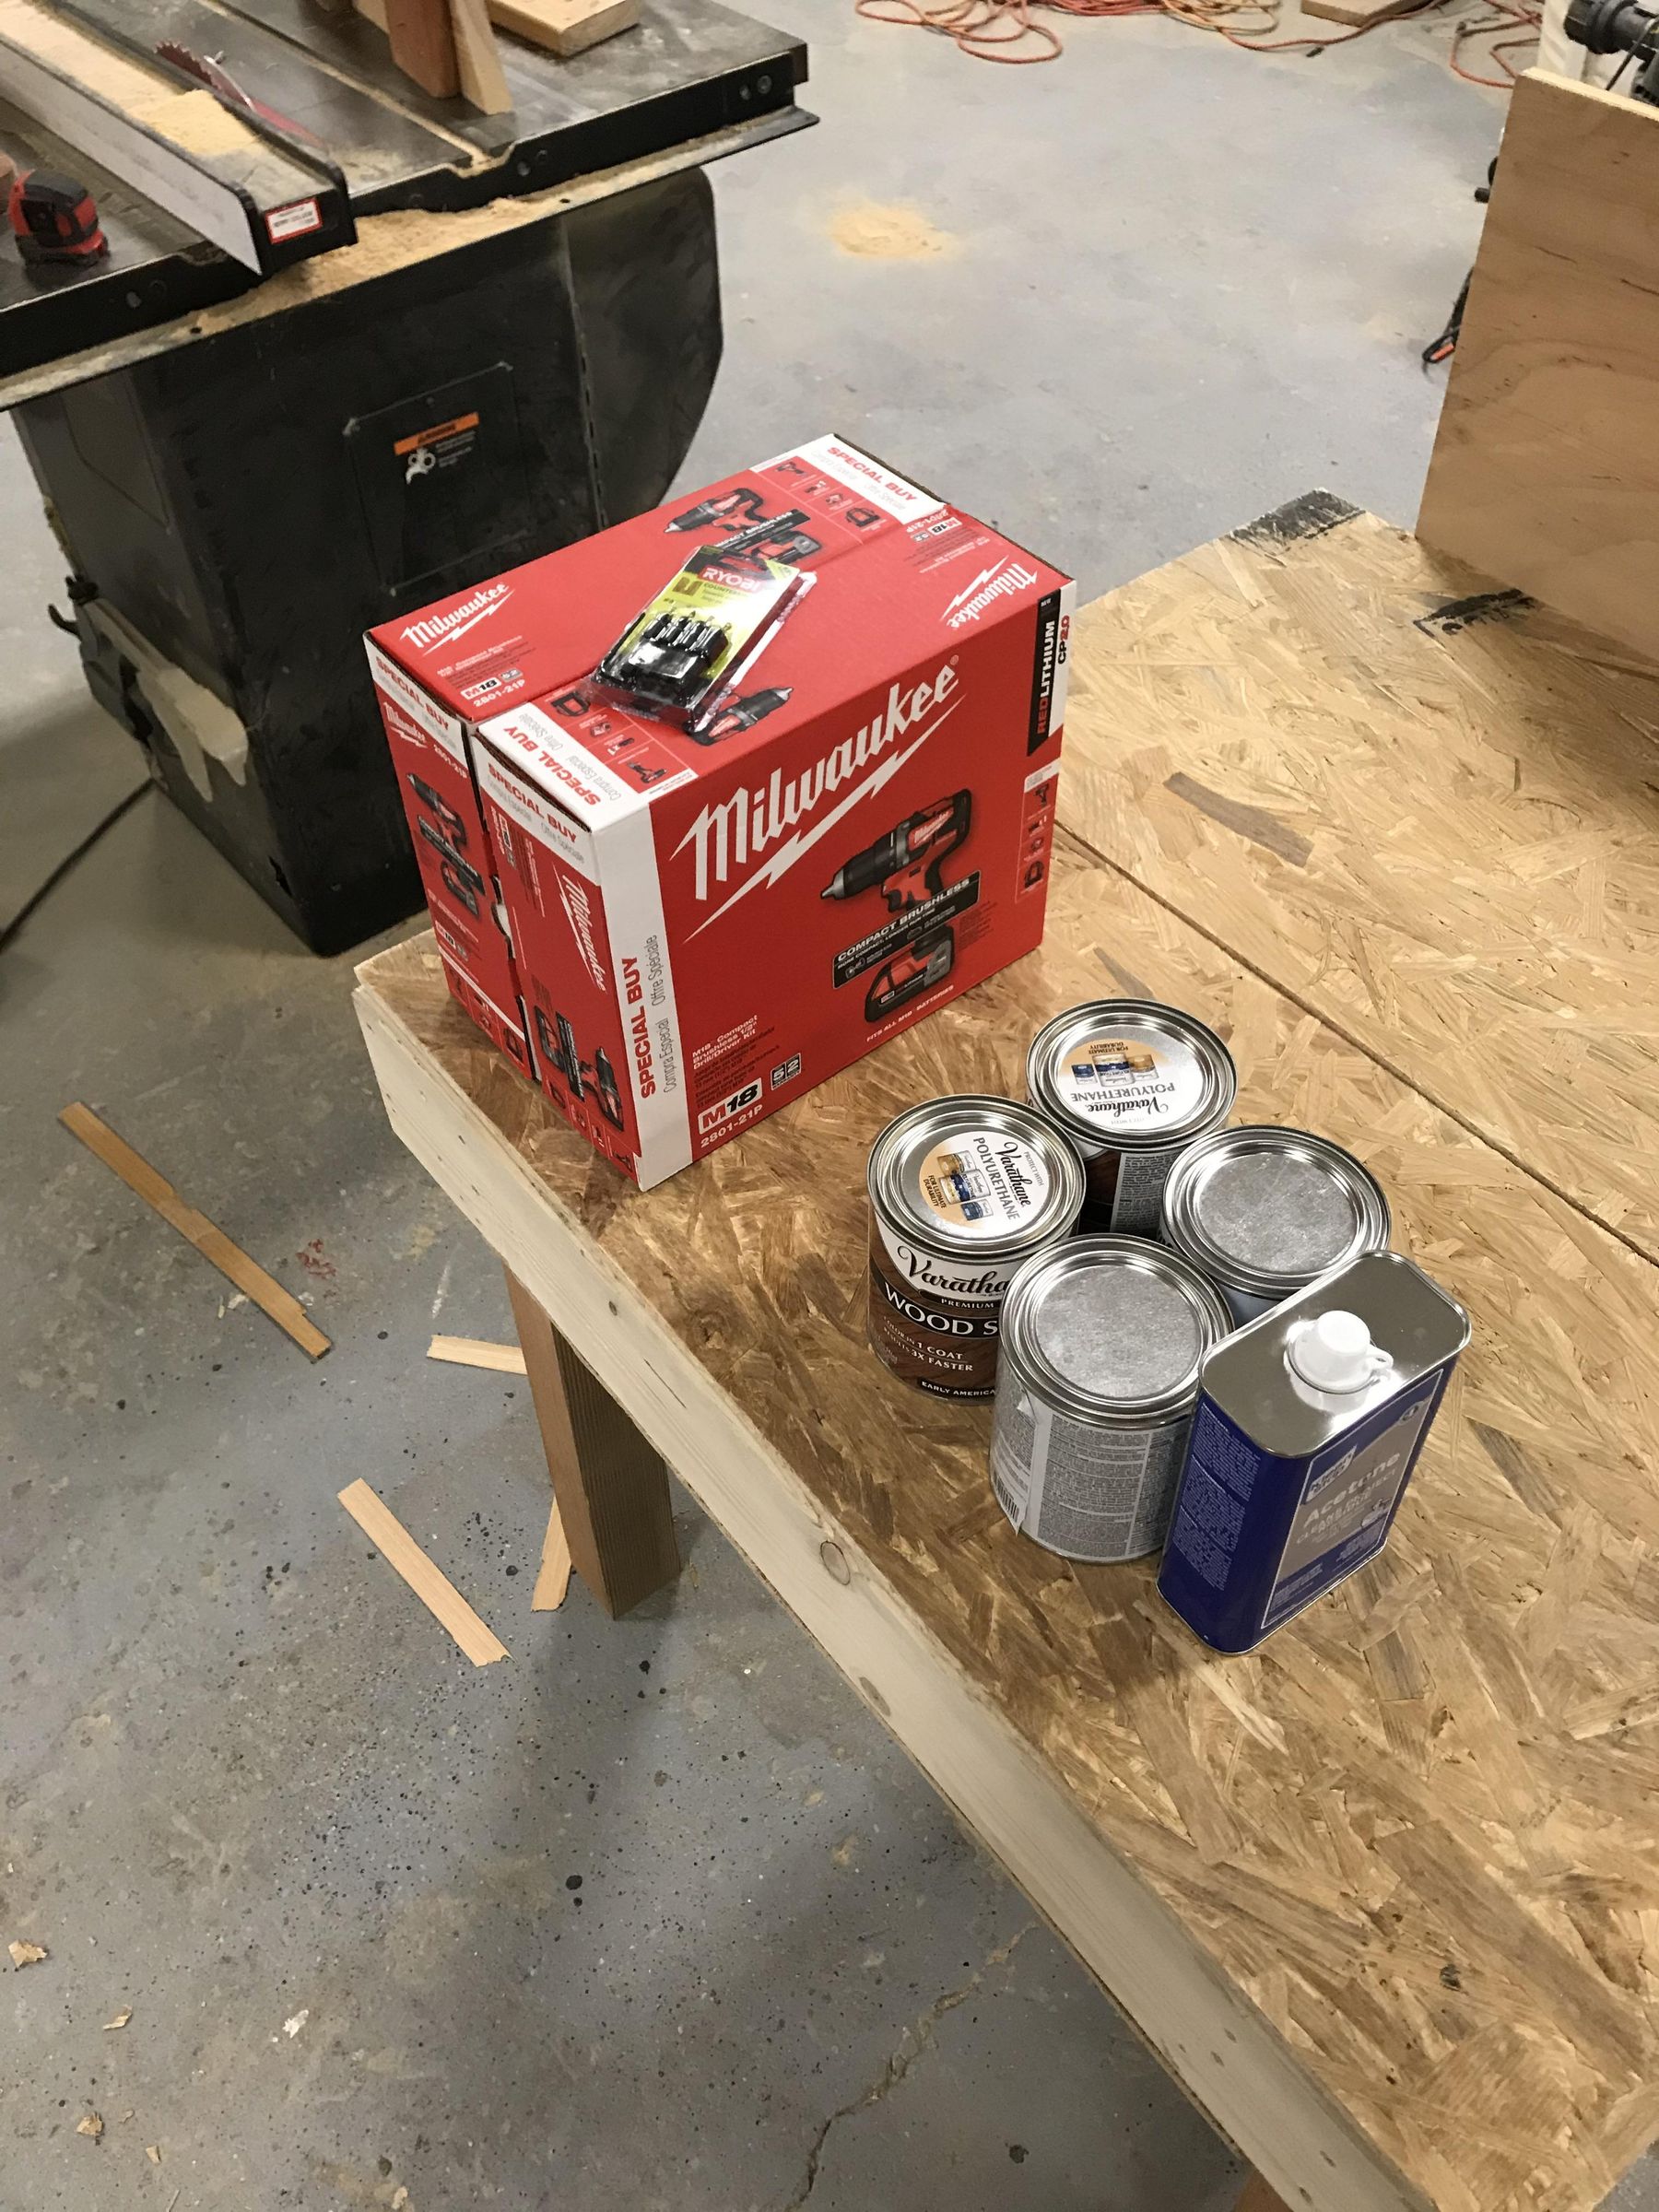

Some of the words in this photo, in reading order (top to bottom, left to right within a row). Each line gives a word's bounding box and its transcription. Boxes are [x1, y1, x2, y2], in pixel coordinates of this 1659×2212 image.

[828, 446, 885, 484] SPECIAL
[885, 482, 918, 501] BUY
[702, 567, 762, 591] RYOBI
[947, 563, 1038, 629] Milwaukee
[399, 582, 510, 648] Milwaukee
[464, 678, 499, 698] M18
[474, 679, 524, 707] 2801-21P
[1037, 620, 1055, 735] REDLITHIUM
[504, 725, 539, 751] BUY
[538, 750, 601, 806] SPECIAL
[670, 665, 959, 900] Milwaukee
[488, 762, 545, 818] SPECIAL
[547, 813, 577, 842] BUY
[562, 875, 607, 994] Milwaukee
[837, 922, 897, 961] COMPACT
[900, 878, 970, 924] BRUSHLESS
[621, 957, 643, 1004] BUY
[651, 980, 665, 1006] Offre
[655, 1018, 675, 1060] Especial
[692, 1042, 711, 1057] M18
[717, 1015, 758, 1042] Compact
[884, 1021, 897, 1031] ALL
[630, 1006, 655, 1099] SPECIAL
[693, 1034, 738, 1064] Brushless
[693, 1038, 741, 1069] Drill/Driver
[743, 1029, 756, 1040] Kit
[659, 1056, 677, 1094] Compra
[1071, 1082, 1176, 1102] POLYURETHANE
[700, 1083, 759, 1131] M18
[700, 1104, 763, 1148] 2801-21P
[1087, 1097, 1169, 1118] Varathane
[924, 1179, 939, 1206] DURABILITY
[928, 1175, 937, 1188] FOR
[934, 1184, 947, 1208] ULTIMATE
[973, 1136, 1021, 1220] POLYURETHANE
[995, 1141, 1033, 1208] Varathane
[897, 1245, 1010, 1293] Varatha
[885, 1282, 974, 1335] WOOD
[941, 1298, 994, 1309] PREMIUM
[912, 1348, 924, 1361] 3X
[928, 1357, 973, 1371] FASTER
[927, 1345, 963, 1360] COAT
[922, 1382, 950, 1394] EARLY
[953, 1386, 995, 1396] AMERICA
